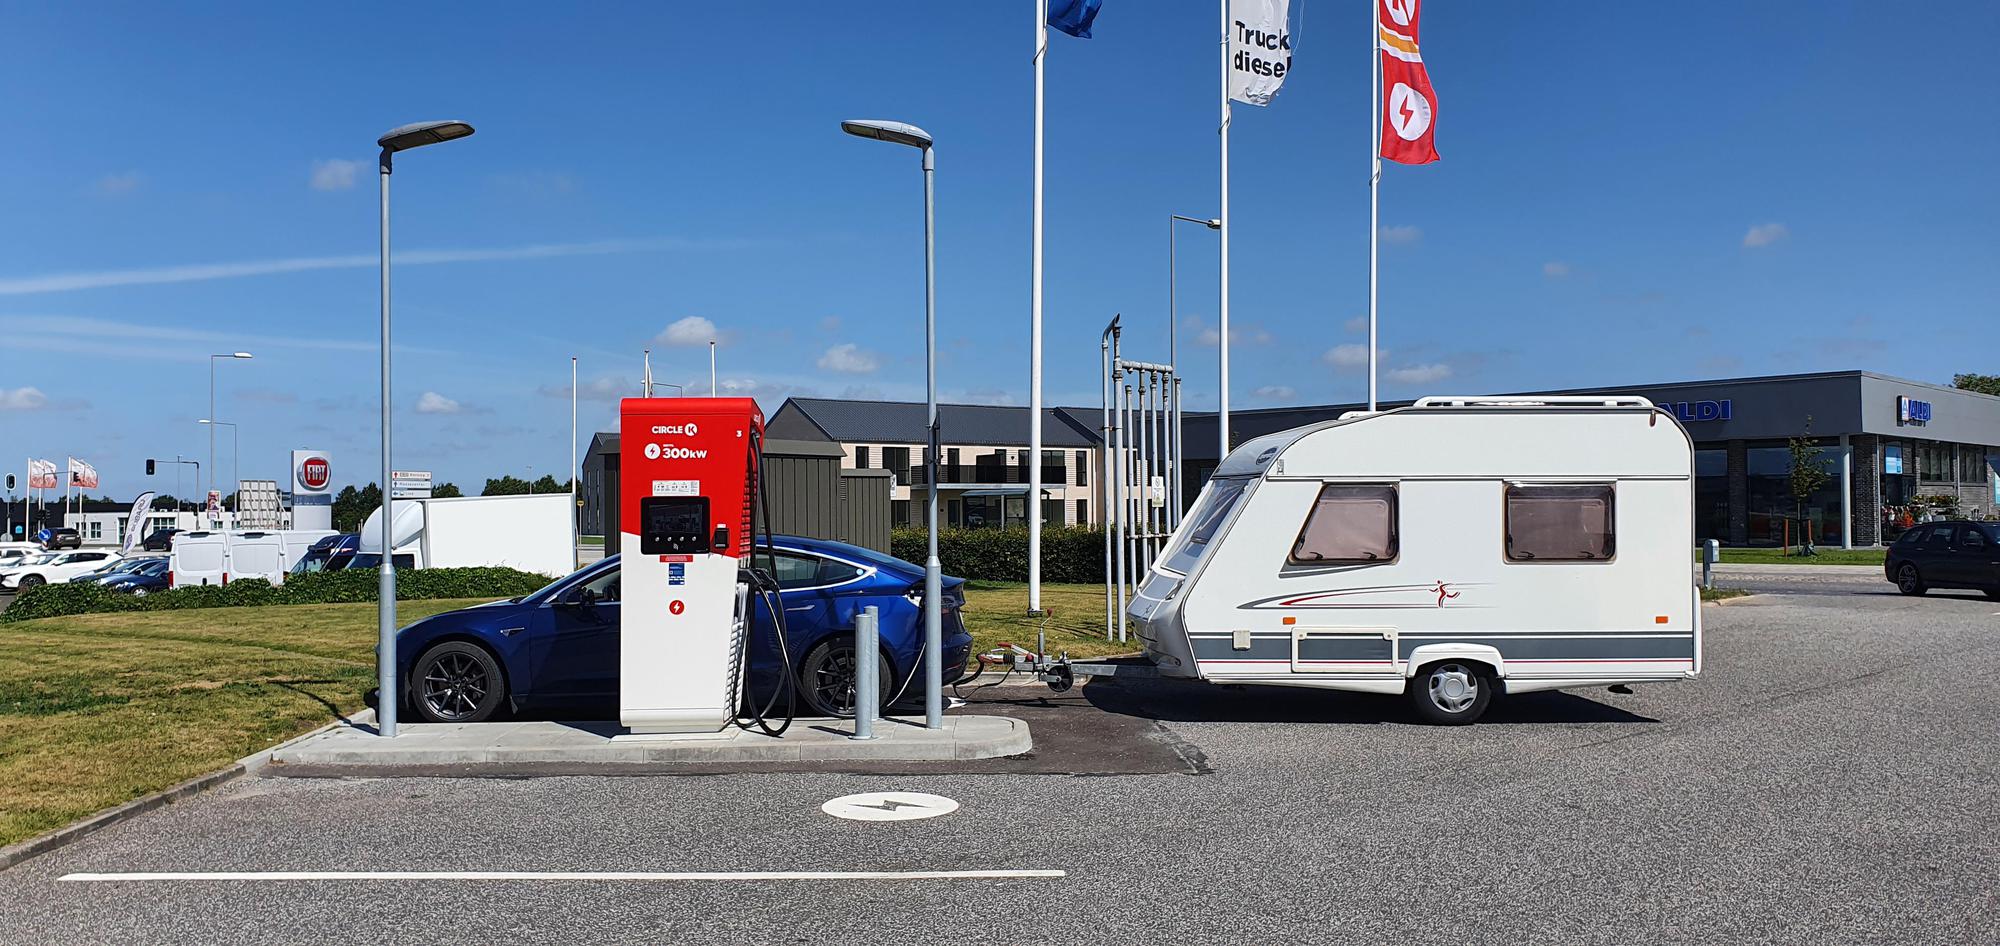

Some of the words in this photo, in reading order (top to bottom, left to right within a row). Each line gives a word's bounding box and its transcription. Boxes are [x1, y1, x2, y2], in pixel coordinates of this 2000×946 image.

[1235, 20, 1290, 50] Truck
[1234, 50, 1292, 78] diesel
[651, 425, 683, 434] CIRCLE
[687, 424, 697, 436] K
[306, 464, 326, 481] FIAT
